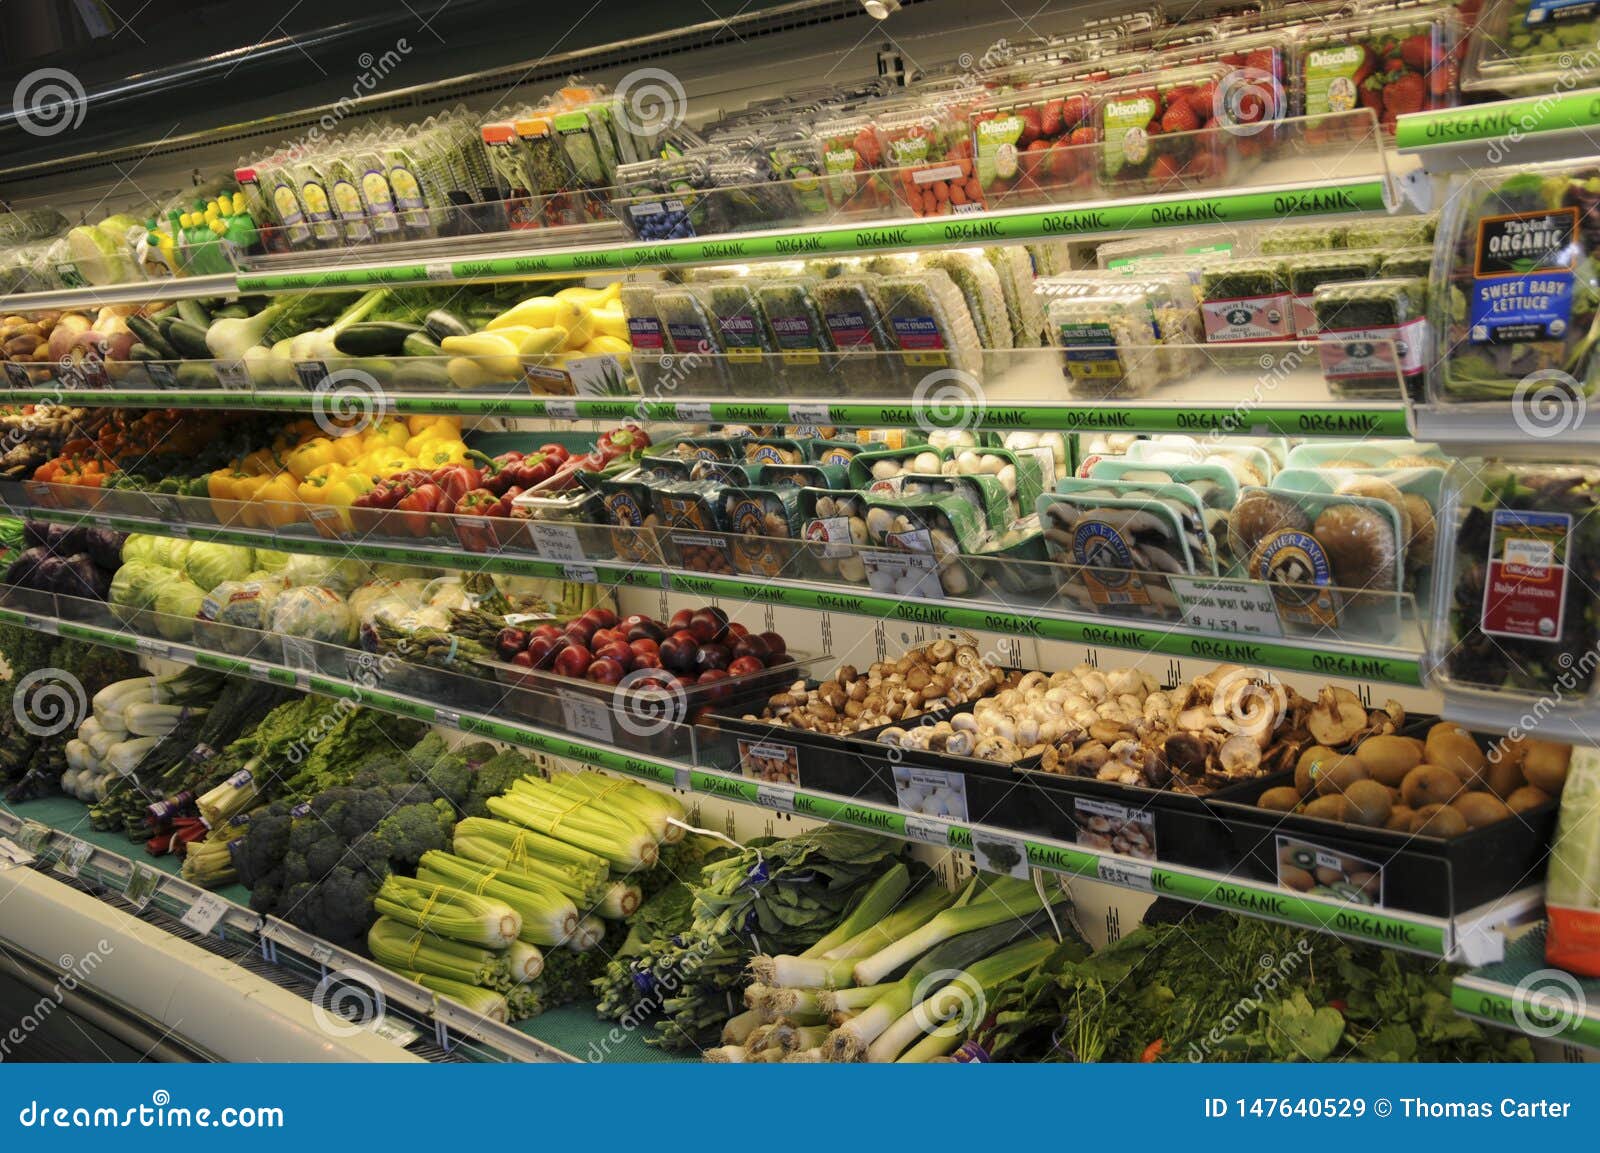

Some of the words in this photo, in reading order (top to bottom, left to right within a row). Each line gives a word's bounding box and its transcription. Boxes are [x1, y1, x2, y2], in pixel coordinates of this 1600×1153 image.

[702, 243, 749, 258] ORGANIC
[775, 237, 826, 252] ORGANIC
[856, 230, 912, 246] ORGANIC
[944, 222, 1005, 240] ORGANIC
[1042, 213, 1110, 232] ORGANIC
[1151, 203, 1226, 223] ORGANIC
[1273, 191, 1360, 213] ORGANIC
[1489, 230, 1563, 252] ORGANIC
[1480, 281, 1526, 300] SWEET
[1530, 281, 1566, 294] BABY
[1493, 296, 1551, 313] LETTUCE
[726, 407, 770, 422] ORGANIC
[1067, 412, 1135, 427] ORGANIC
[1299, 414, 1385, 431] ORGANIC
[816, 594, 865, 610] ORGANIC
[897, 605, 953, 623] ORGANIC
[984, 615, 1046, 636] ORGANIC
[1081, 627, 1146, 648] ORGANIC
[1191, 640, 1265, 661] ORGANIC
[1312, 654, 1394, 676] ORGANIC
[625, 759, 665, 779] ORGANIC
[703, 777, 746, 797] ORGANIC
[844, 807, 895, 829] ORGANIC
[1214, 887, 1290, 916] ORGANIC
[1335, 913, 1421, 945] ORGANIC
